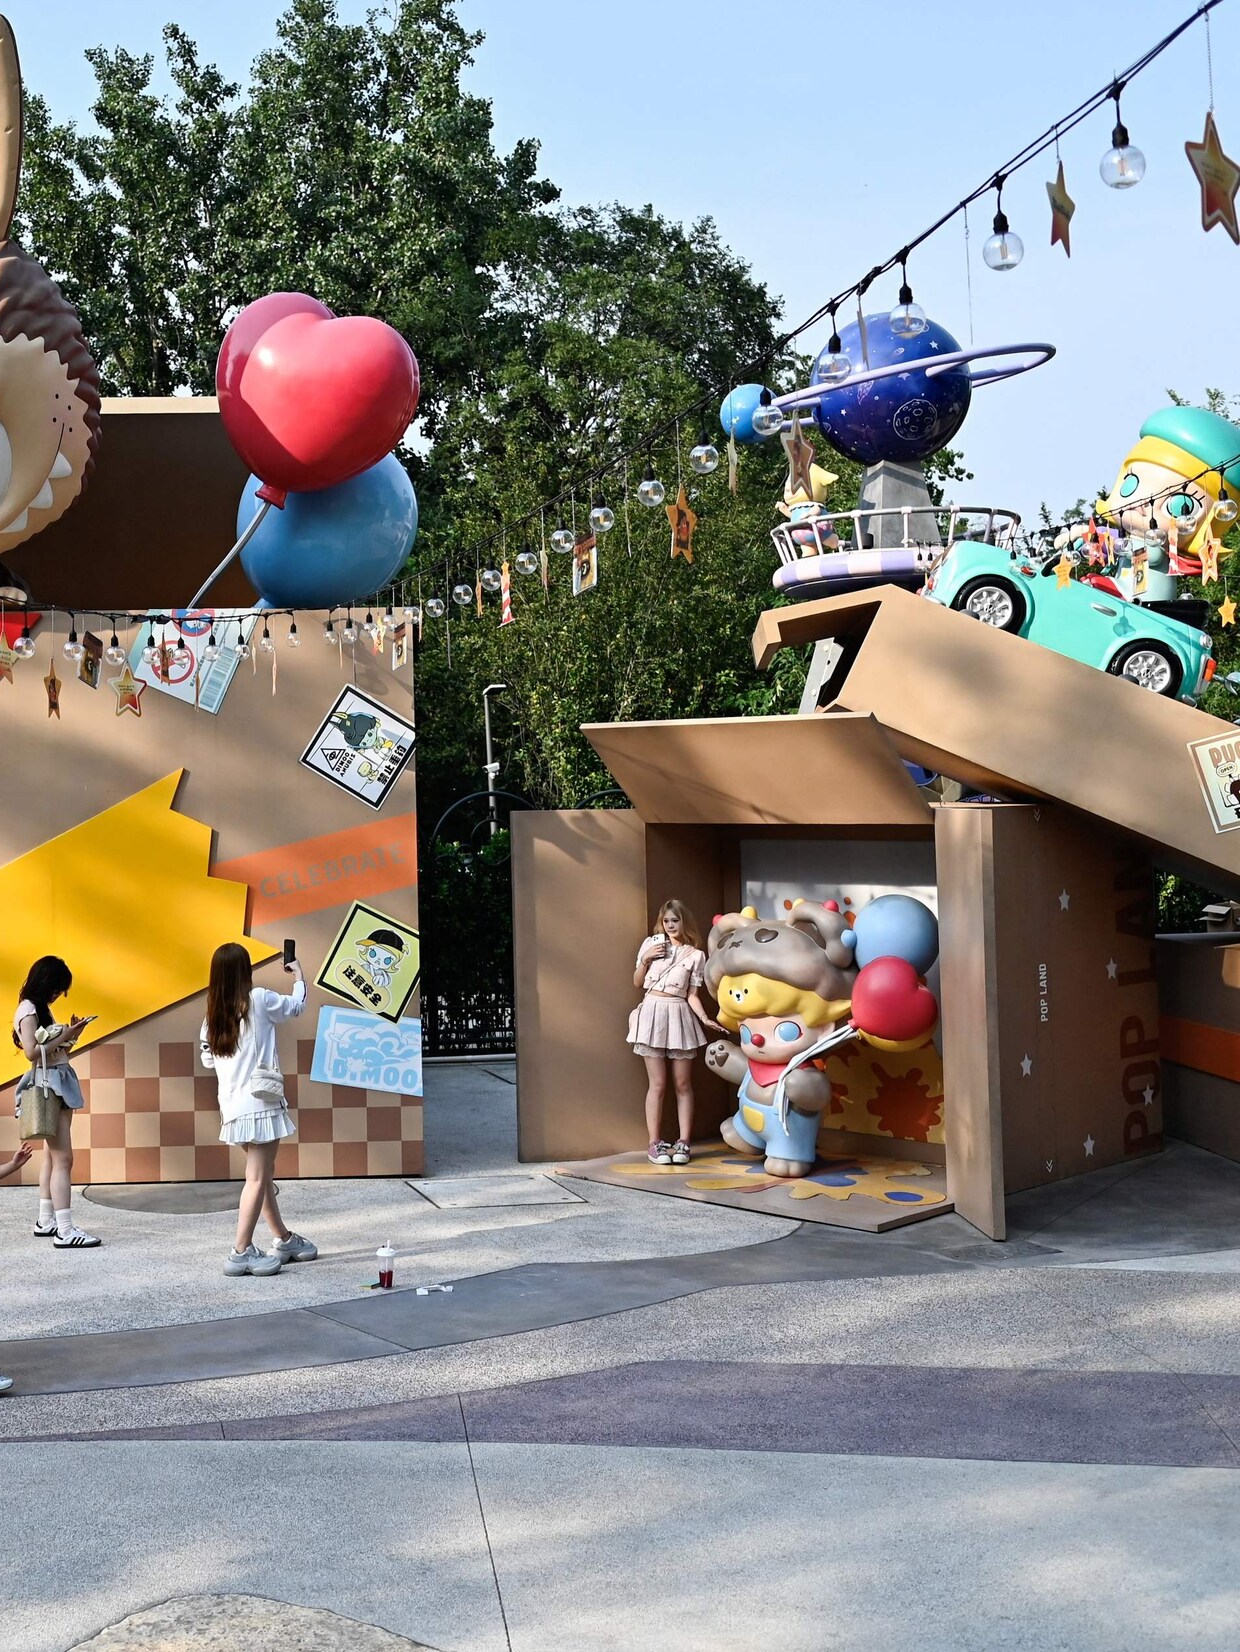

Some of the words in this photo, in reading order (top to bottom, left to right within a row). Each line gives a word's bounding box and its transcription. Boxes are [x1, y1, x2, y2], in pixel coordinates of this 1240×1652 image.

[335, 752, 350, 772] DIMOO
[261, 841, 407, 899] CELEBRATE
[342, 964, 384, 1006] 注意安全
[1039, 963, 1047, 995] LAND
[1040, 998, 1049, 1022] POP
[1121, 1014, 1162, 1156] POP
